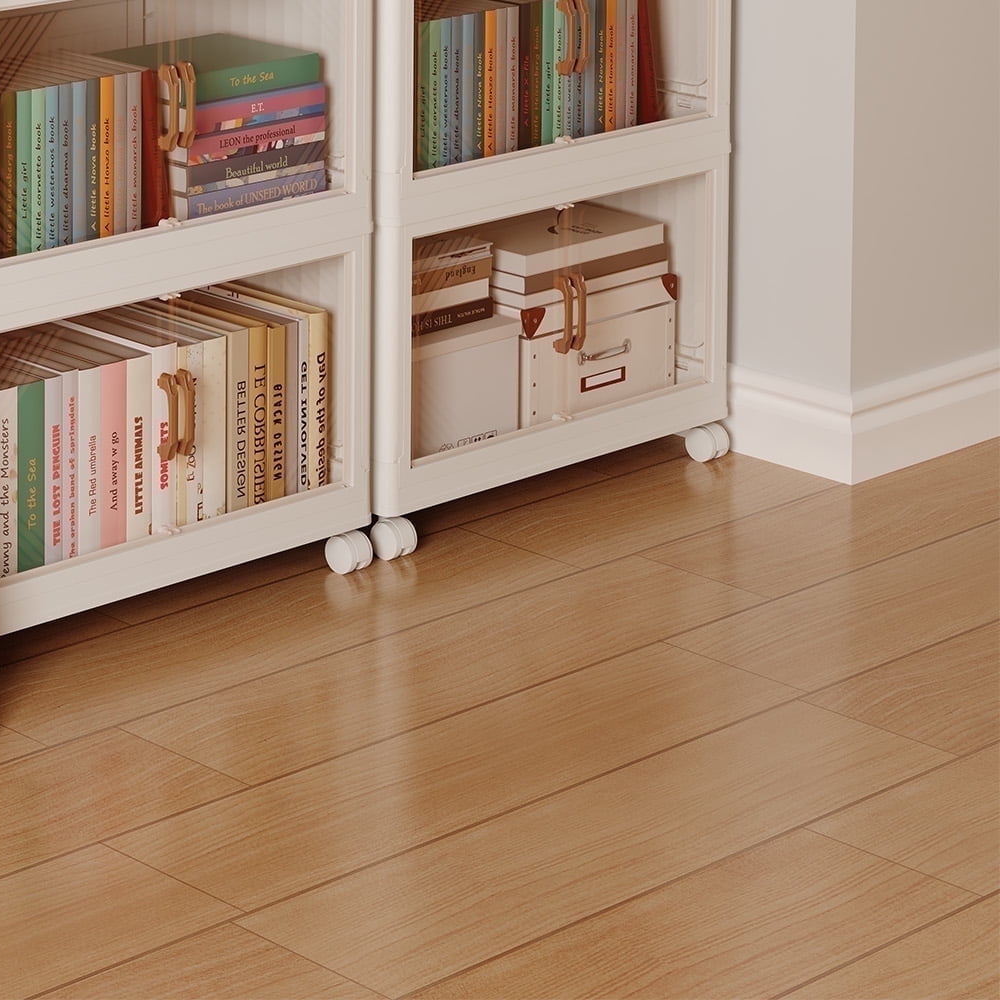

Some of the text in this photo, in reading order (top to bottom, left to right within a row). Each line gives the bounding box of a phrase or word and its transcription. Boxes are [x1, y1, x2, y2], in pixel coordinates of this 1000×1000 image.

[230, 71, 275, 88] To the Sea
[251, 102, 265, 114] E.T.
[47, 115, 55, 144] book
[61, 119, 69, 148] book
[103, 116, 111, 145] book
[219, 125, 297, 150] LEON the professional
[90, 123, 98, 231] A little Nova book
[225, 155, 289, 180] Beautiful world
[21, 161, 31, 219] Little girl
[103, 190, 111, 218] little
[196, 202, 213, 216] The
[214, 197, 236, 212] book
[236, 194, 244, 207] of
[282, 179, 320, 198] WORLD
[103, 222, 111, 232] A
[444, 263, 477, 282] England
[0, 417, 10, 480] Monsters
[88, 435, 97, 517] The Red umbrella
[109, 431, 120, 512] And away w go
[134, 416, 143, 515] LITTLE ANIMALS
[0, 483, 10, 507] the
[26, 457, 37, 529] To the Sea
[52, 424, 61, 547] THE LOST PENGUIN
[0, 511, 10, 537] and
